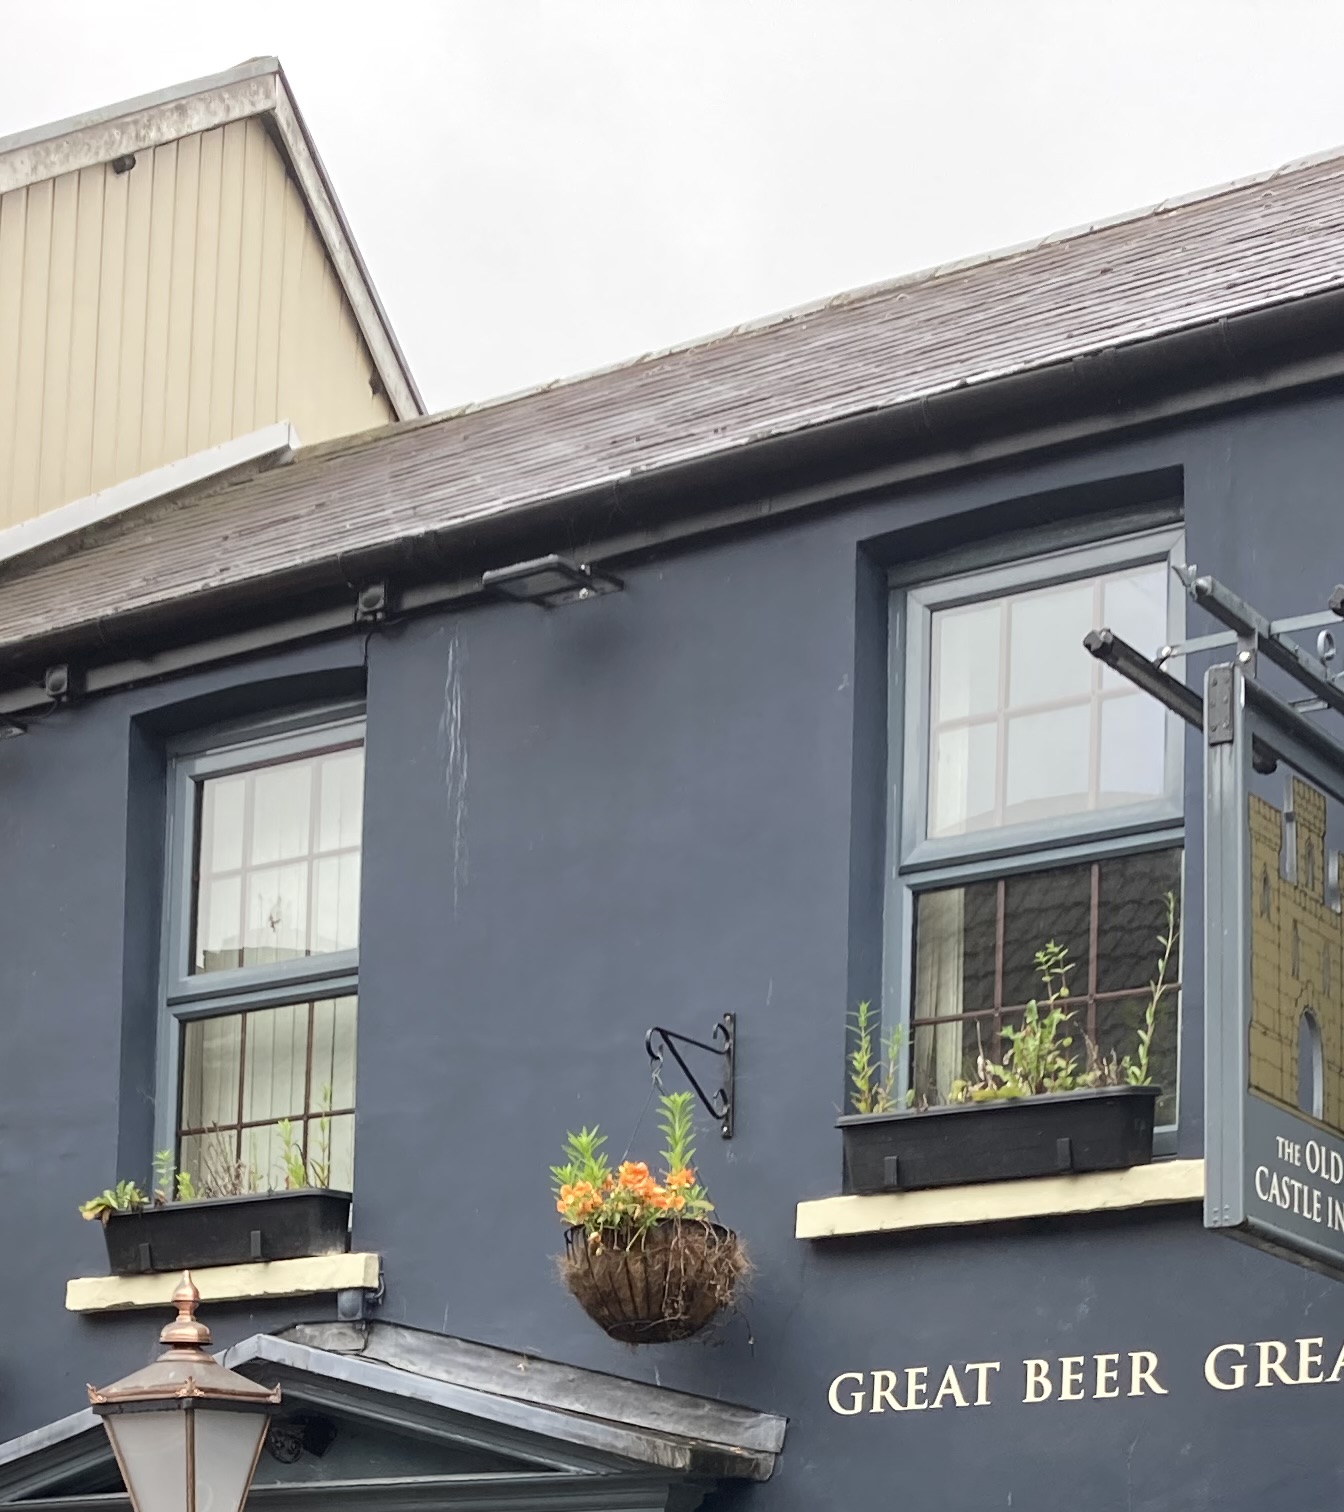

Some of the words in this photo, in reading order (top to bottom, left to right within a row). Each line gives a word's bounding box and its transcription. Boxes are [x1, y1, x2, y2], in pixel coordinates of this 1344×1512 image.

[1276, 1136, 1301, 1166] THE
[1305, 1140, 1343, 1184] OLD
[1255, 1166, 1321, 1222] CASTLE
[828, 1361, 1000, 1415] GREAT
[1022, 1351, 1169, 1403] BEER
